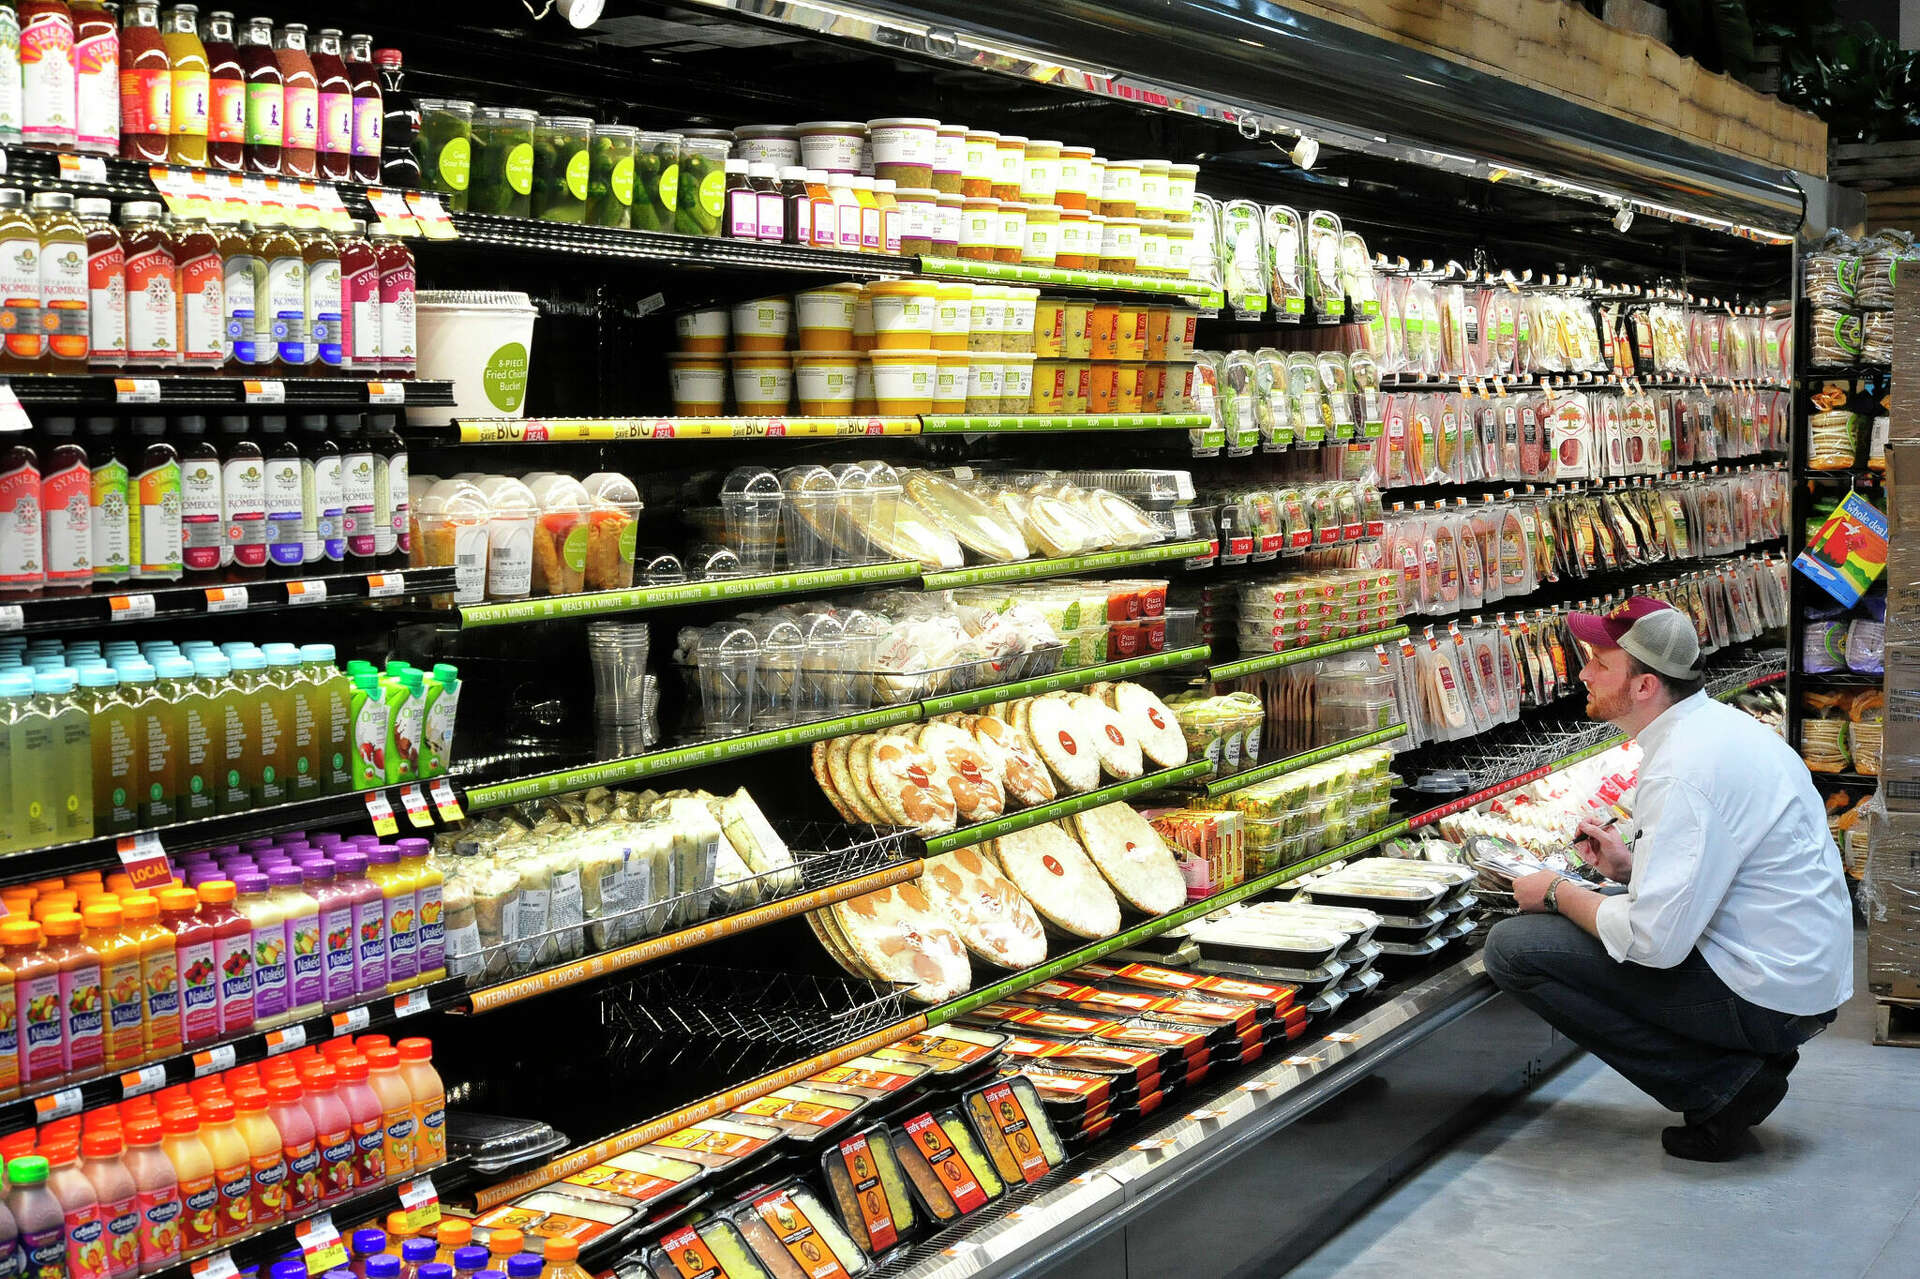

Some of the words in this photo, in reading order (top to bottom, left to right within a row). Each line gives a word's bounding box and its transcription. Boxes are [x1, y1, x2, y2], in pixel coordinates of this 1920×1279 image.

[95, 251, 124, 271] SYNE
[133, 255, 175, 273] SYNERG
[44, 286, 87, 295] KOMBUC
[498, 359, 524, 367] 8-PIECE
[486, 370, 507, 379] Fried
[480, 432, 496, 440] SAVE
[497, 423, 519, 440] BIG
[527, 432, 544, 440] DEAL
[656, 429, 670, 438] DEAL
[1, 474, 39, 493] SYNERG
[1847, 503, 1870, 524] whole
[1868, 519, 1888, 537] deal
[468, 611, 491, 622] MEALS
[938, 700, 953, 709] PIZZA
[473, 791, 496, 803] MEALS
[513, 782, 540, 795] MINUTE
[130, 862, 168, 883] LOCAL
[611, 938, 671, 967] INTERNATIONAL
[674, 927, 706, 947] FLAVORS
[476, 976, 544, 1008] INTERNATIONAL
[548, 964, 584, 986] FLAVORS
[615, 1117, 674, 1151] INTERNATIONAL
[679, 1103, 709, 1125] FLAVORS
[480, 1168, 548, 1206] INTERNATIONAL
[552, 1152, 588, 1177] FLAVORS
